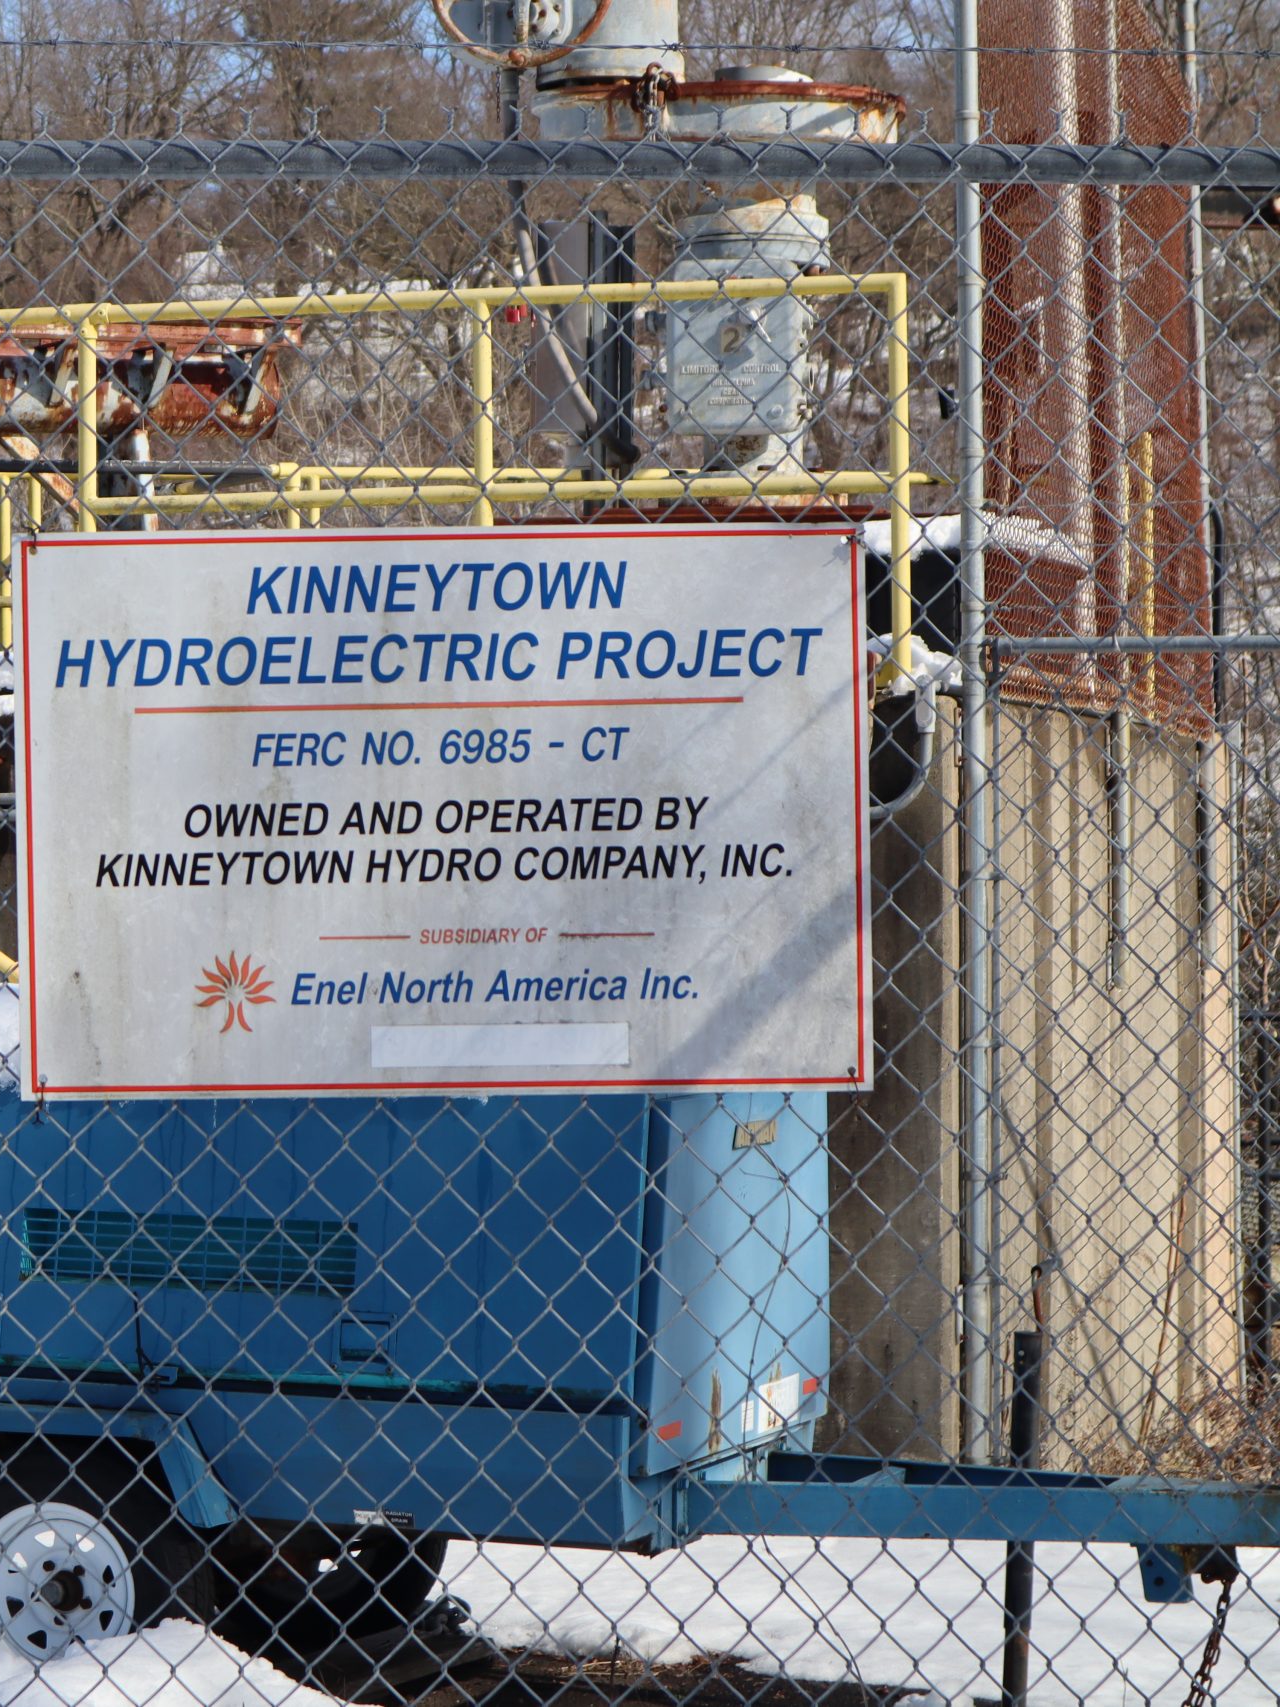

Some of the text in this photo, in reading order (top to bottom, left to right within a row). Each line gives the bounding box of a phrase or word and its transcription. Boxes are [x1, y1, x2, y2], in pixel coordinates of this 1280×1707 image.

[723, 327, 740, 353] 2
[246, 560, 627, 615] KINNEYTOWN
[55, 627, 824, 689] HYDROELECTRIC PROJECT
[252, 730, 347, 768] FERC
[361, 729, 421, 767] NO.
[439, 728, 532, 765] 6985
[581, 726, 631, 763] CT
[184, 796, 710, 839] OWNED AND OPERATED BY
[95, 842, 793, 888] KINNEYTOWN HYDRO COMPANY, INC.
[419, 926, 548, 945] SUBSIDIARY OF
[290, 967, 699, 1006] Enel North America Inc.
